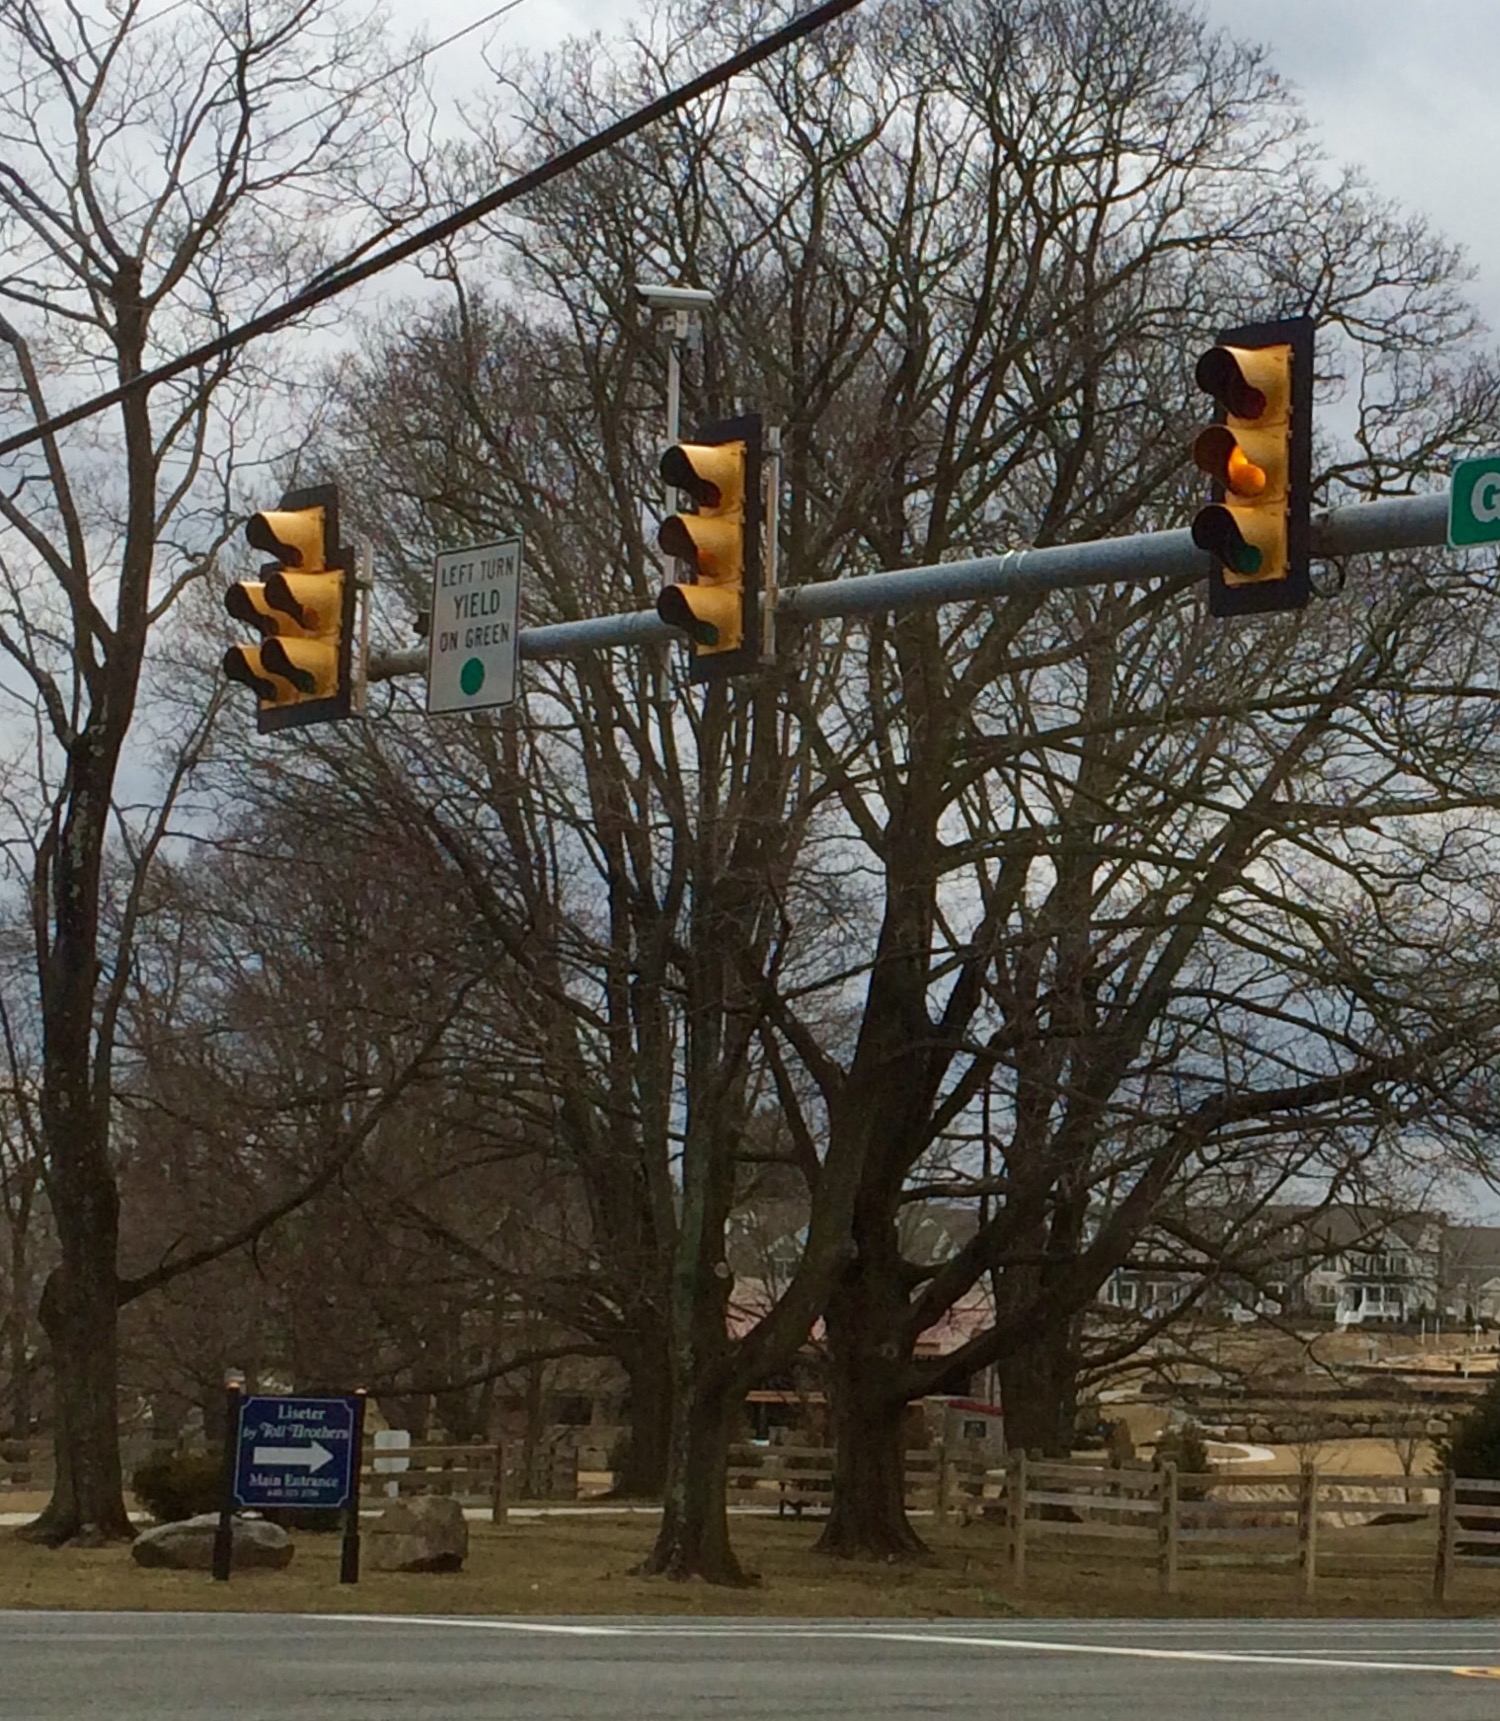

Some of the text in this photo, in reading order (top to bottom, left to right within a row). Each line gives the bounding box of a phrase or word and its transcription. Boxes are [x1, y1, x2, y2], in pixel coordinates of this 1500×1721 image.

[441, 556, 514, 587] LEFT TURN
[453, 589, 501, 620] YIELD
[439, 623, 510, 652] ON GREEN
[277, 1404, 326, 1420] Liseter
[243, 1421, 349, 1441] by Toll Brothers
[249, 1473, 339, 1488] Main Entrance
